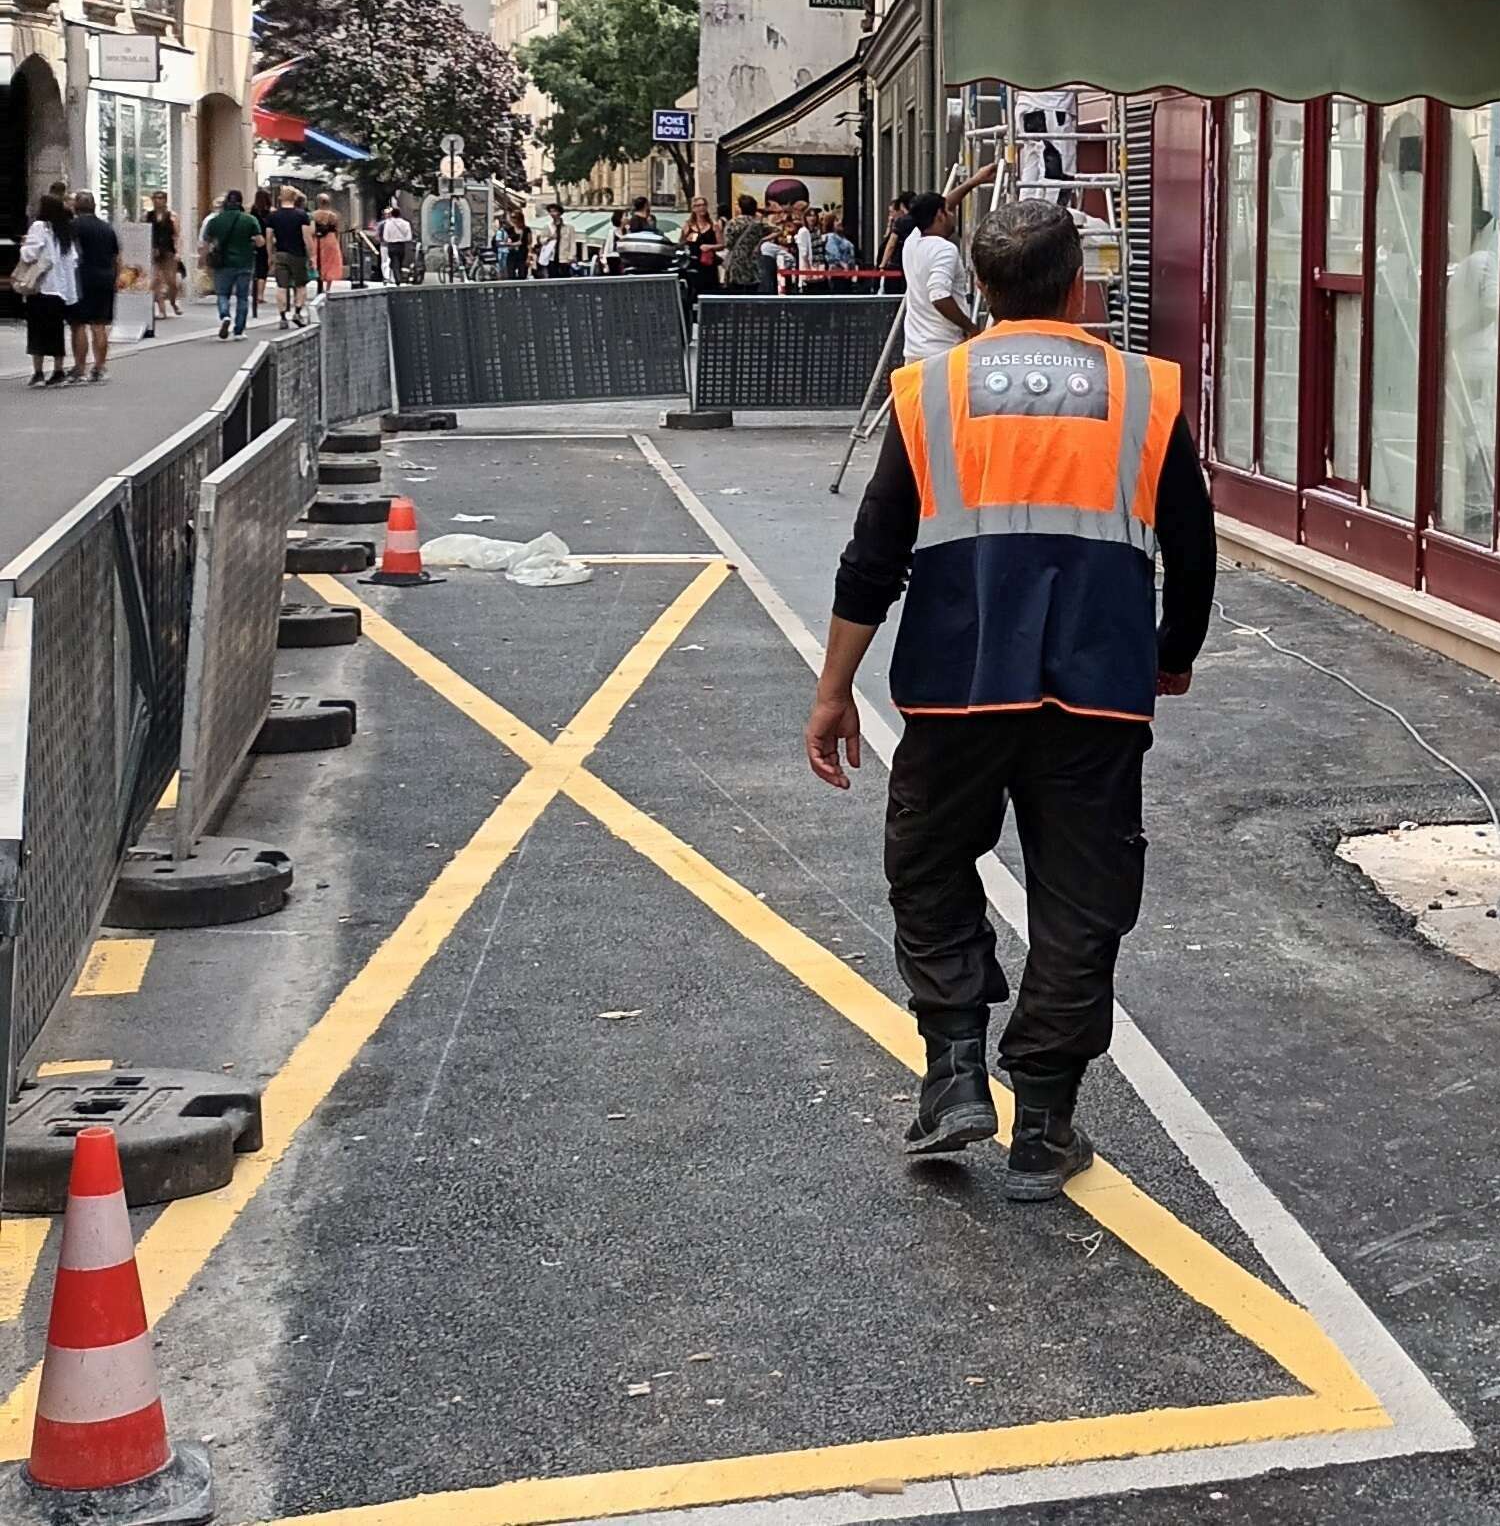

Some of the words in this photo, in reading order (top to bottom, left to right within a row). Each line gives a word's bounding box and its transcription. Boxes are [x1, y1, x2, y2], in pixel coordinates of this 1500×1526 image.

[657, 126, 687, 136] BOWL
[981, 354, 1020, 366] BASE
[1024, 352, 1095, 368] SÉCURITÉ
